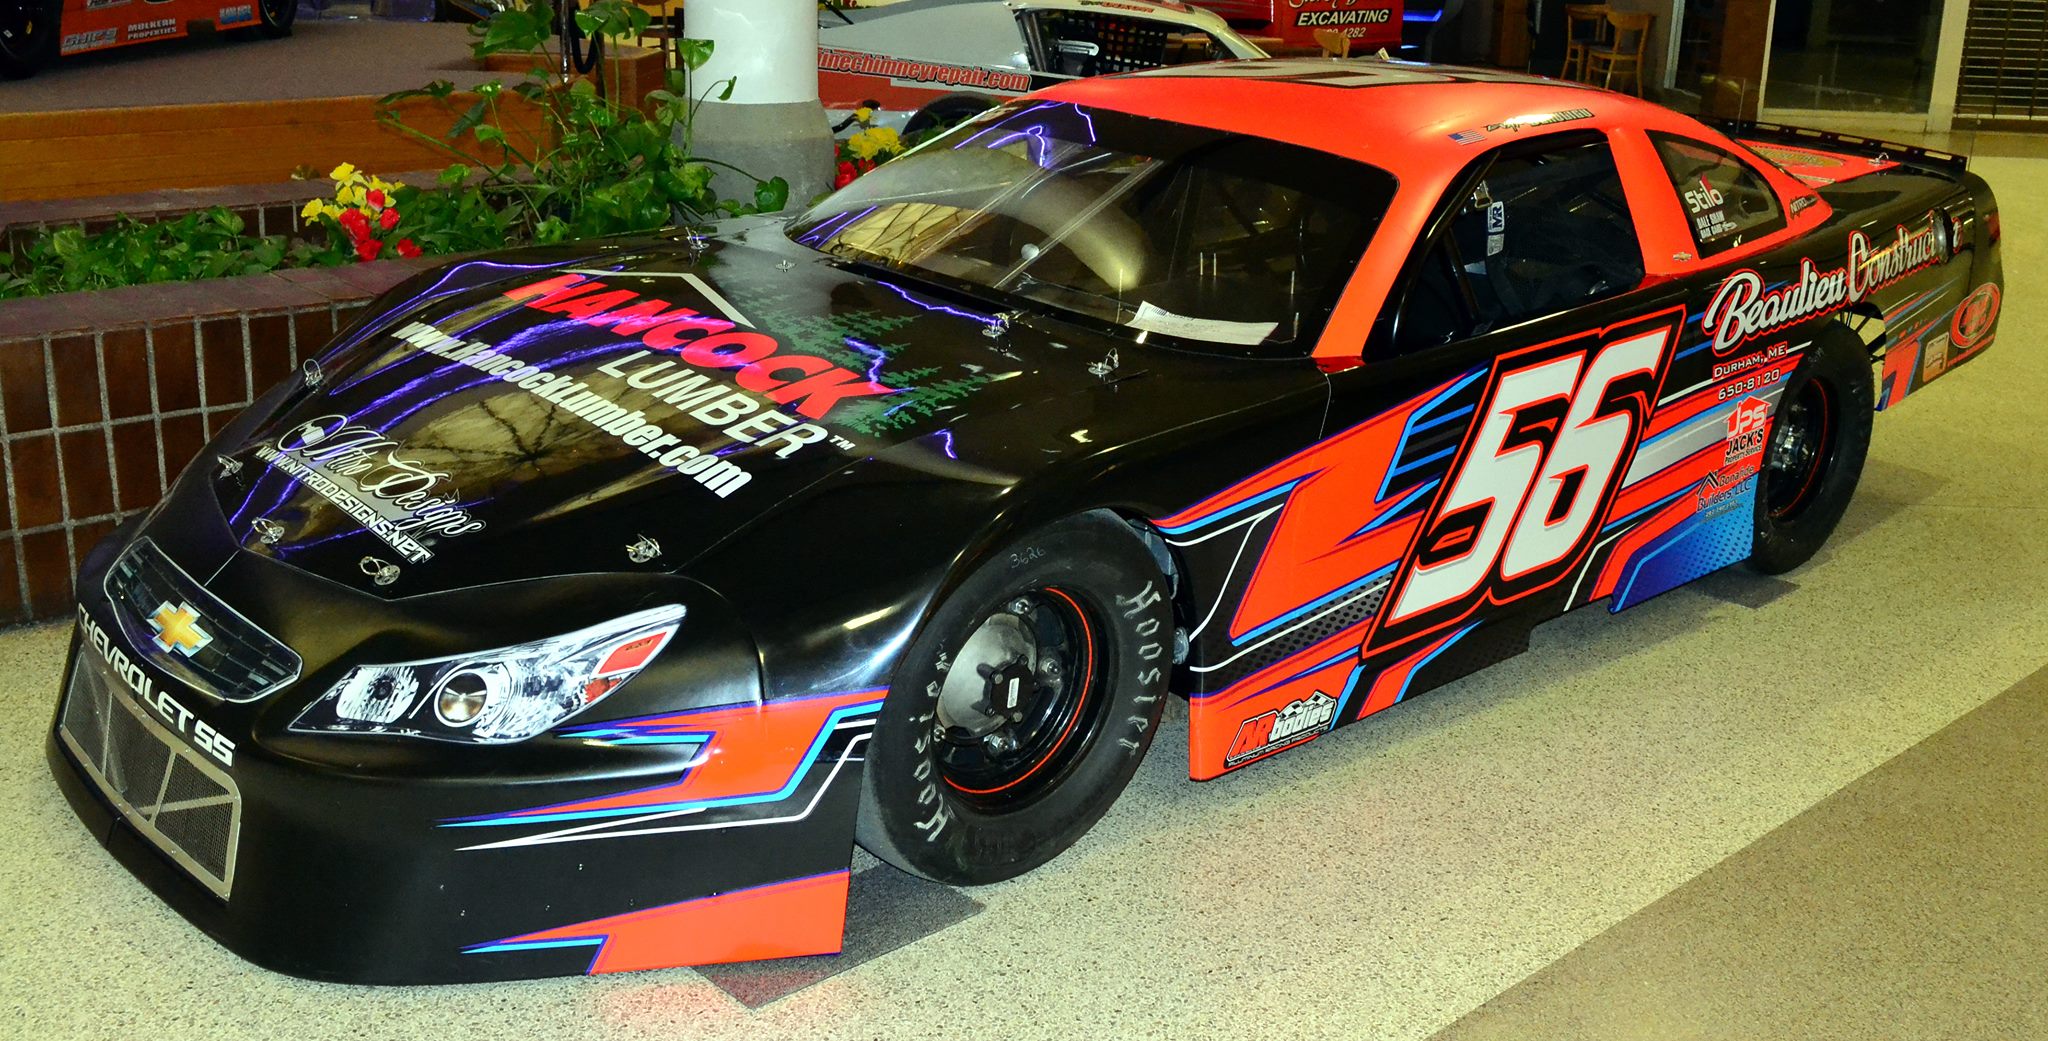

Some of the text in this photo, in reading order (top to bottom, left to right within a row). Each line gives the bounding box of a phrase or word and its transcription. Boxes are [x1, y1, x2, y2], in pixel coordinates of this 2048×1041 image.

[128, 27, 177, 40] PROPERTIES
[1297, 9, 1389, 26] EXCAVATING
[818, 49, 1030, 91] inechimneyrepair.com
[1684, 180, 1724, 213] Stilo
[1703, 260, 1847, 351] Beaulieu
[504, 273, 902, 420] HANCOCK
[1768, 345, 1786, 359] ME
[1718, 369, 1780, 400] 650-8120
[597, 350, 828, 459] LUMBER
[1726, 428, 1764, 456] JACK'S
[1384, 325, 1673, 628] 56
[1010, 547, 1046, 569] 3626
[78, 602, 237, 767] CHEVROLET SS
